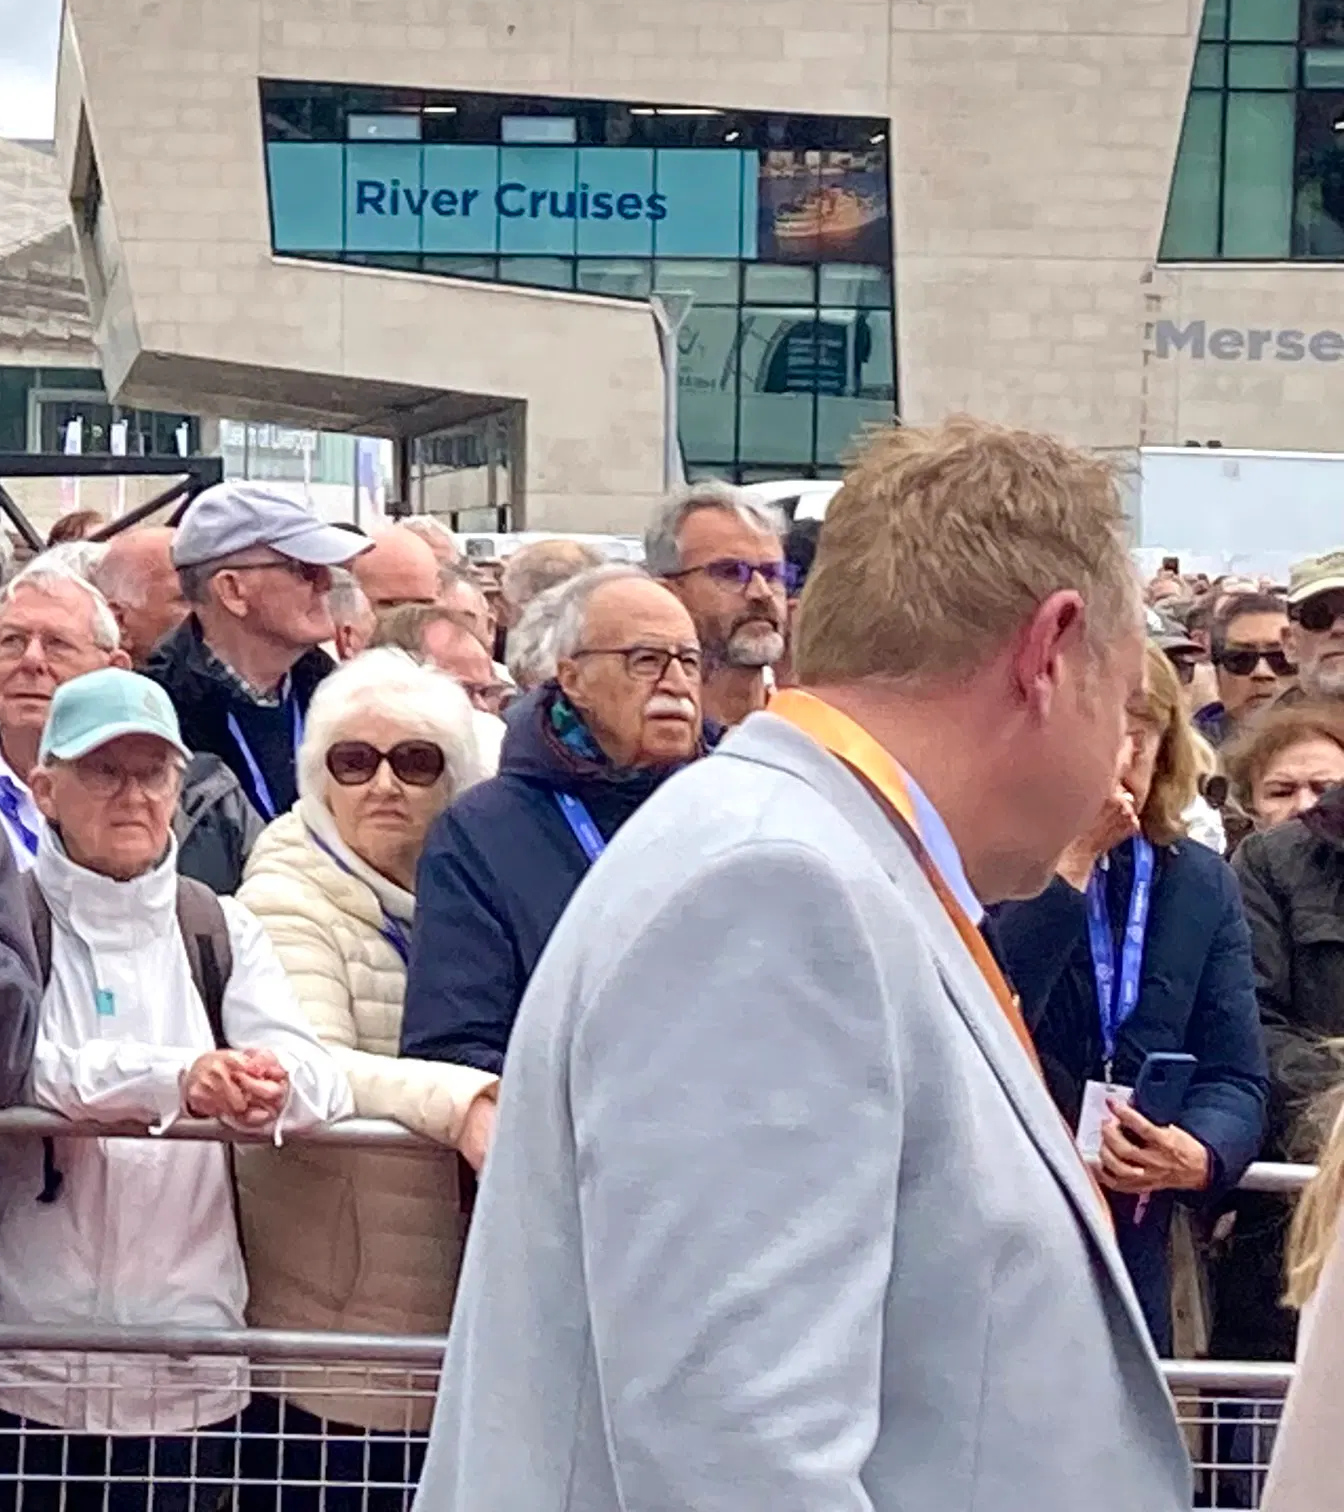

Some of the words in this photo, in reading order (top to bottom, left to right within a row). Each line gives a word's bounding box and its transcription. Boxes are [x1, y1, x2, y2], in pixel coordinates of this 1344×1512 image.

[356, 178, 479, 216] River
[494, 182, 668, 220] Cruises
[1155, 319, 1344, 362] Merse
